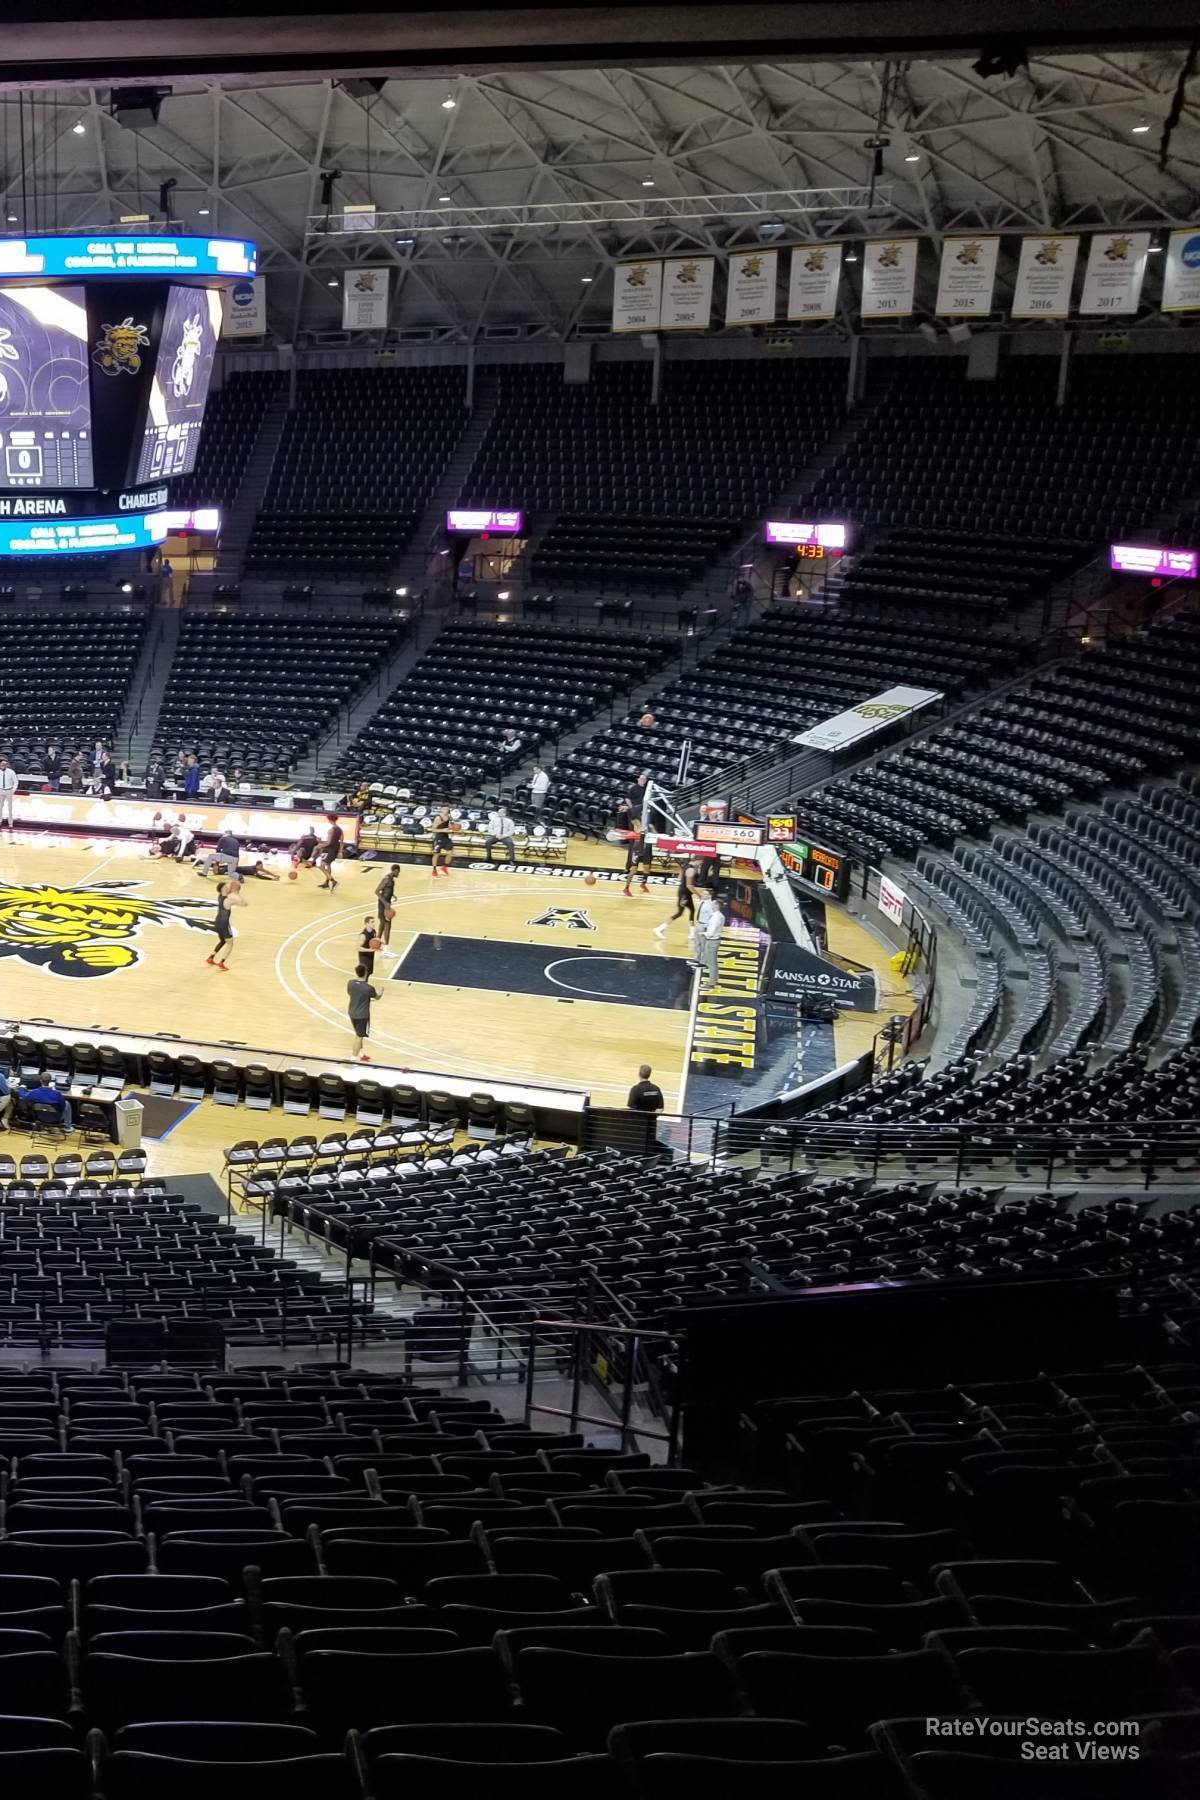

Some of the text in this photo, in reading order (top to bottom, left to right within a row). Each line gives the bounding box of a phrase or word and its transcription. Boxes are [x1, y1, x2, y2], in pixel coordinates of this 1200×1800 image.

[18, 450, 31, 469] 0
[13, 499, 67, 515] ARENA
[119, 492, 158, 510] CHARLES
[797, 545, 824, 558] 4:33
[774, 968, 816, 984] KANSAS
[831, 976, 862, 990] STAR
[691, 1002, 757, 1069] STATE
